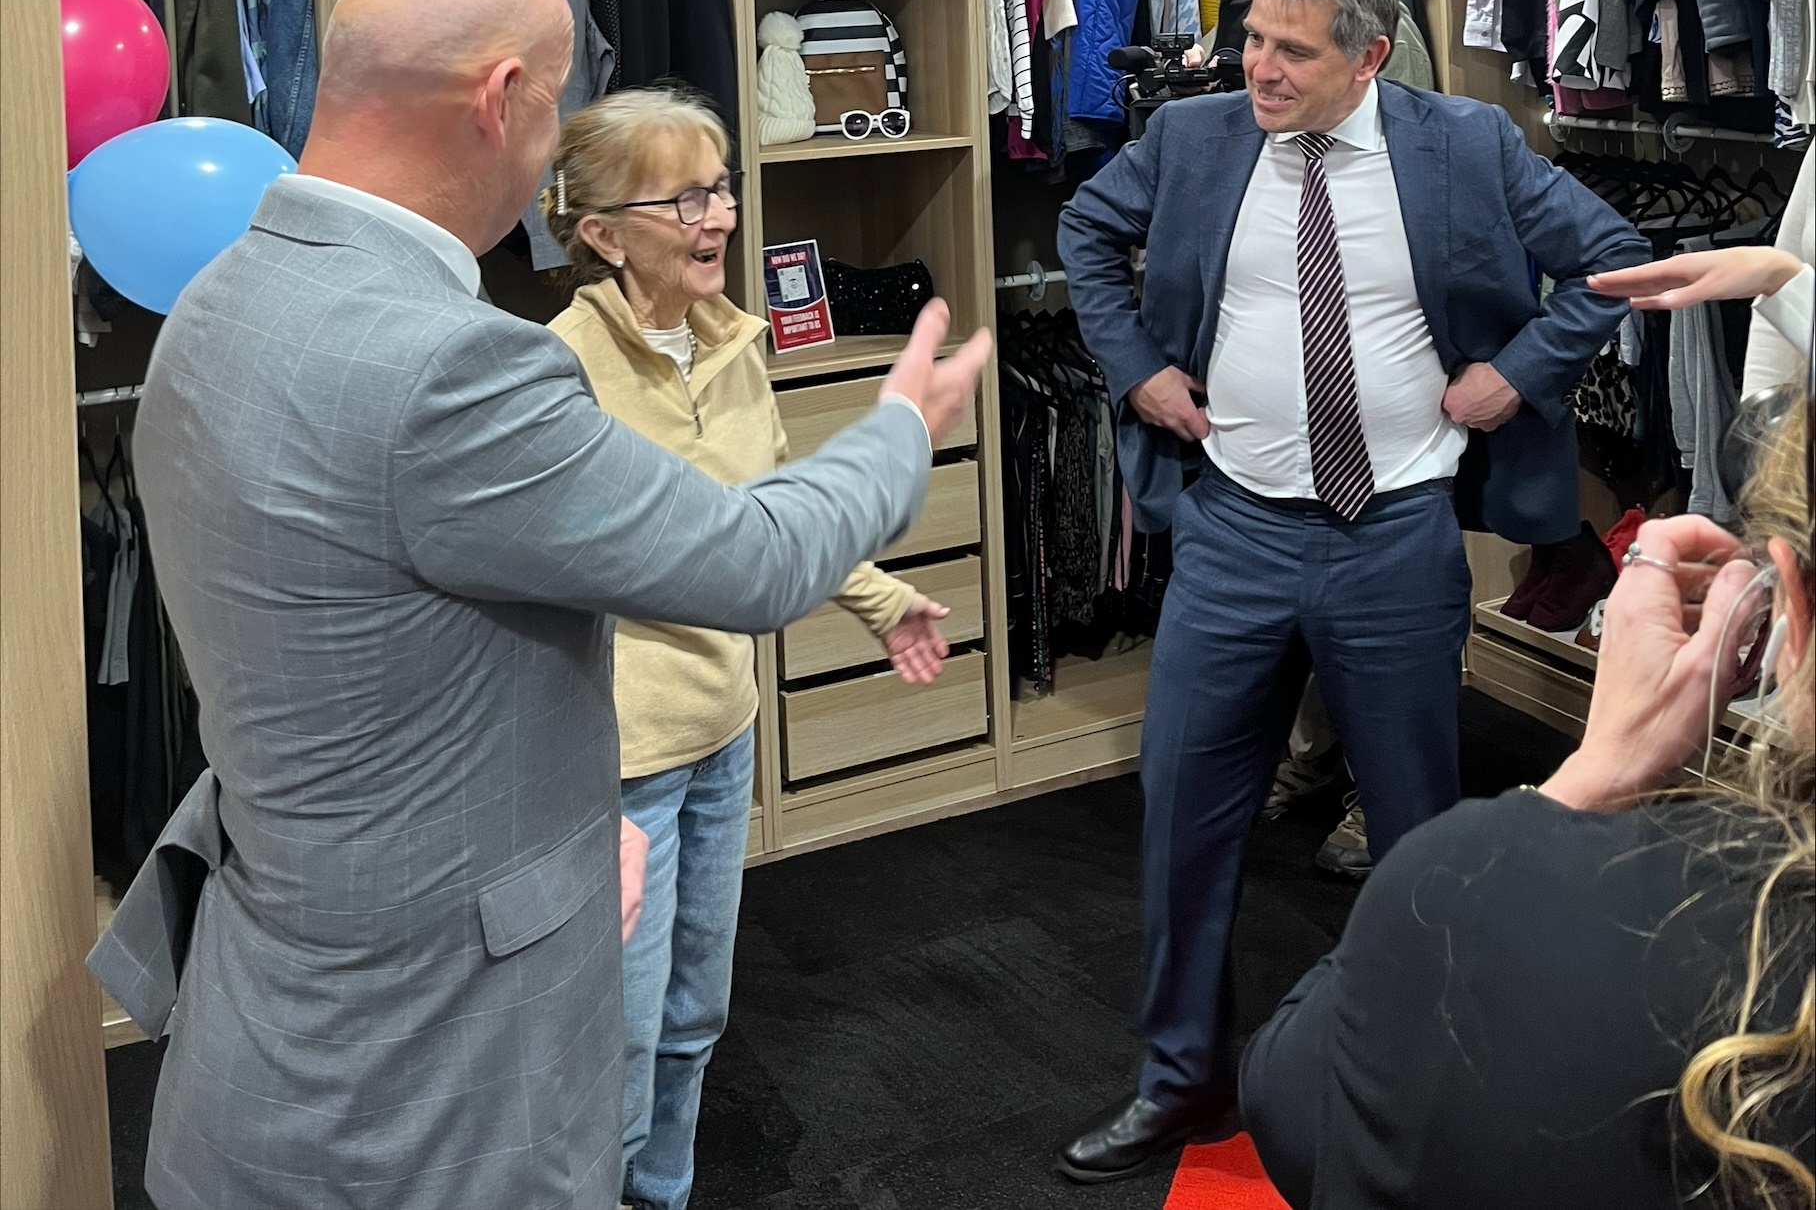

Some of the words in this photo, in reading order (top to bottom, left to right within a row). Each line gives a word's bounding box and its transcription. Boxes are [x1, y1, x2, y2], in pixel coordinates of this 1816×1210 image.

[771, 255, 782, 265] HOW
[790, 252, 797, 262] WE
[780, 315, 793, 325] YOUR
[792, 311, 815, 323] FEEDBACK
[814, 310, 820, 319] IS
[783, 322, 808, 335] IMPORTANT
[807, 321, 815, 330] TO
[814, 319, 821, 329] US
